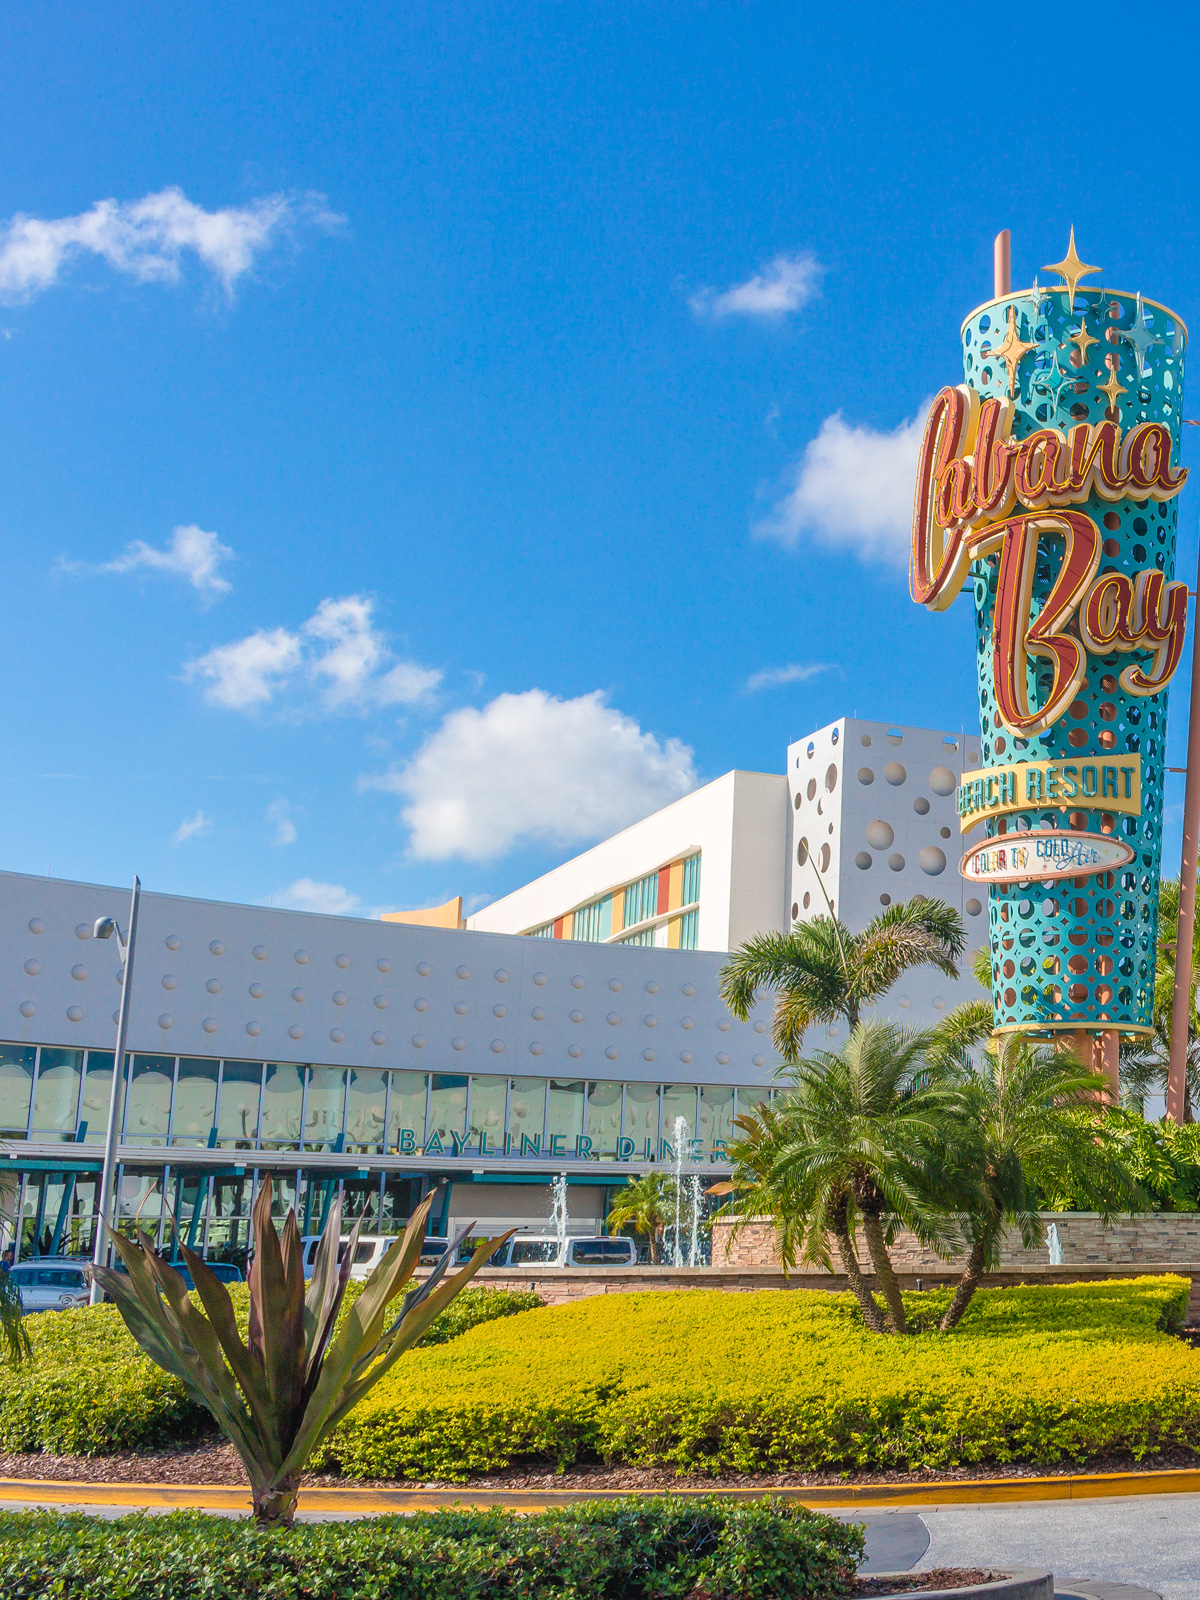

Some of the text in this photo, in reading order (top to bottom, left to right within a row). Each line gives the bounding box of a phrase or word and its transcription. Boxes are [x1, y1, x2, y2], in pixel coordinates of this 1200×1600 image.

[909, 384, 1190, 611] Cabana
[964, 510, 1189, 739] Bay
[956, 765, 1136, 817] BEACH RESORT
[972, 838, 1100, 875] COLOR TV COLD Air
[398, 1127, 735, 1161] BAYLINER DINER
